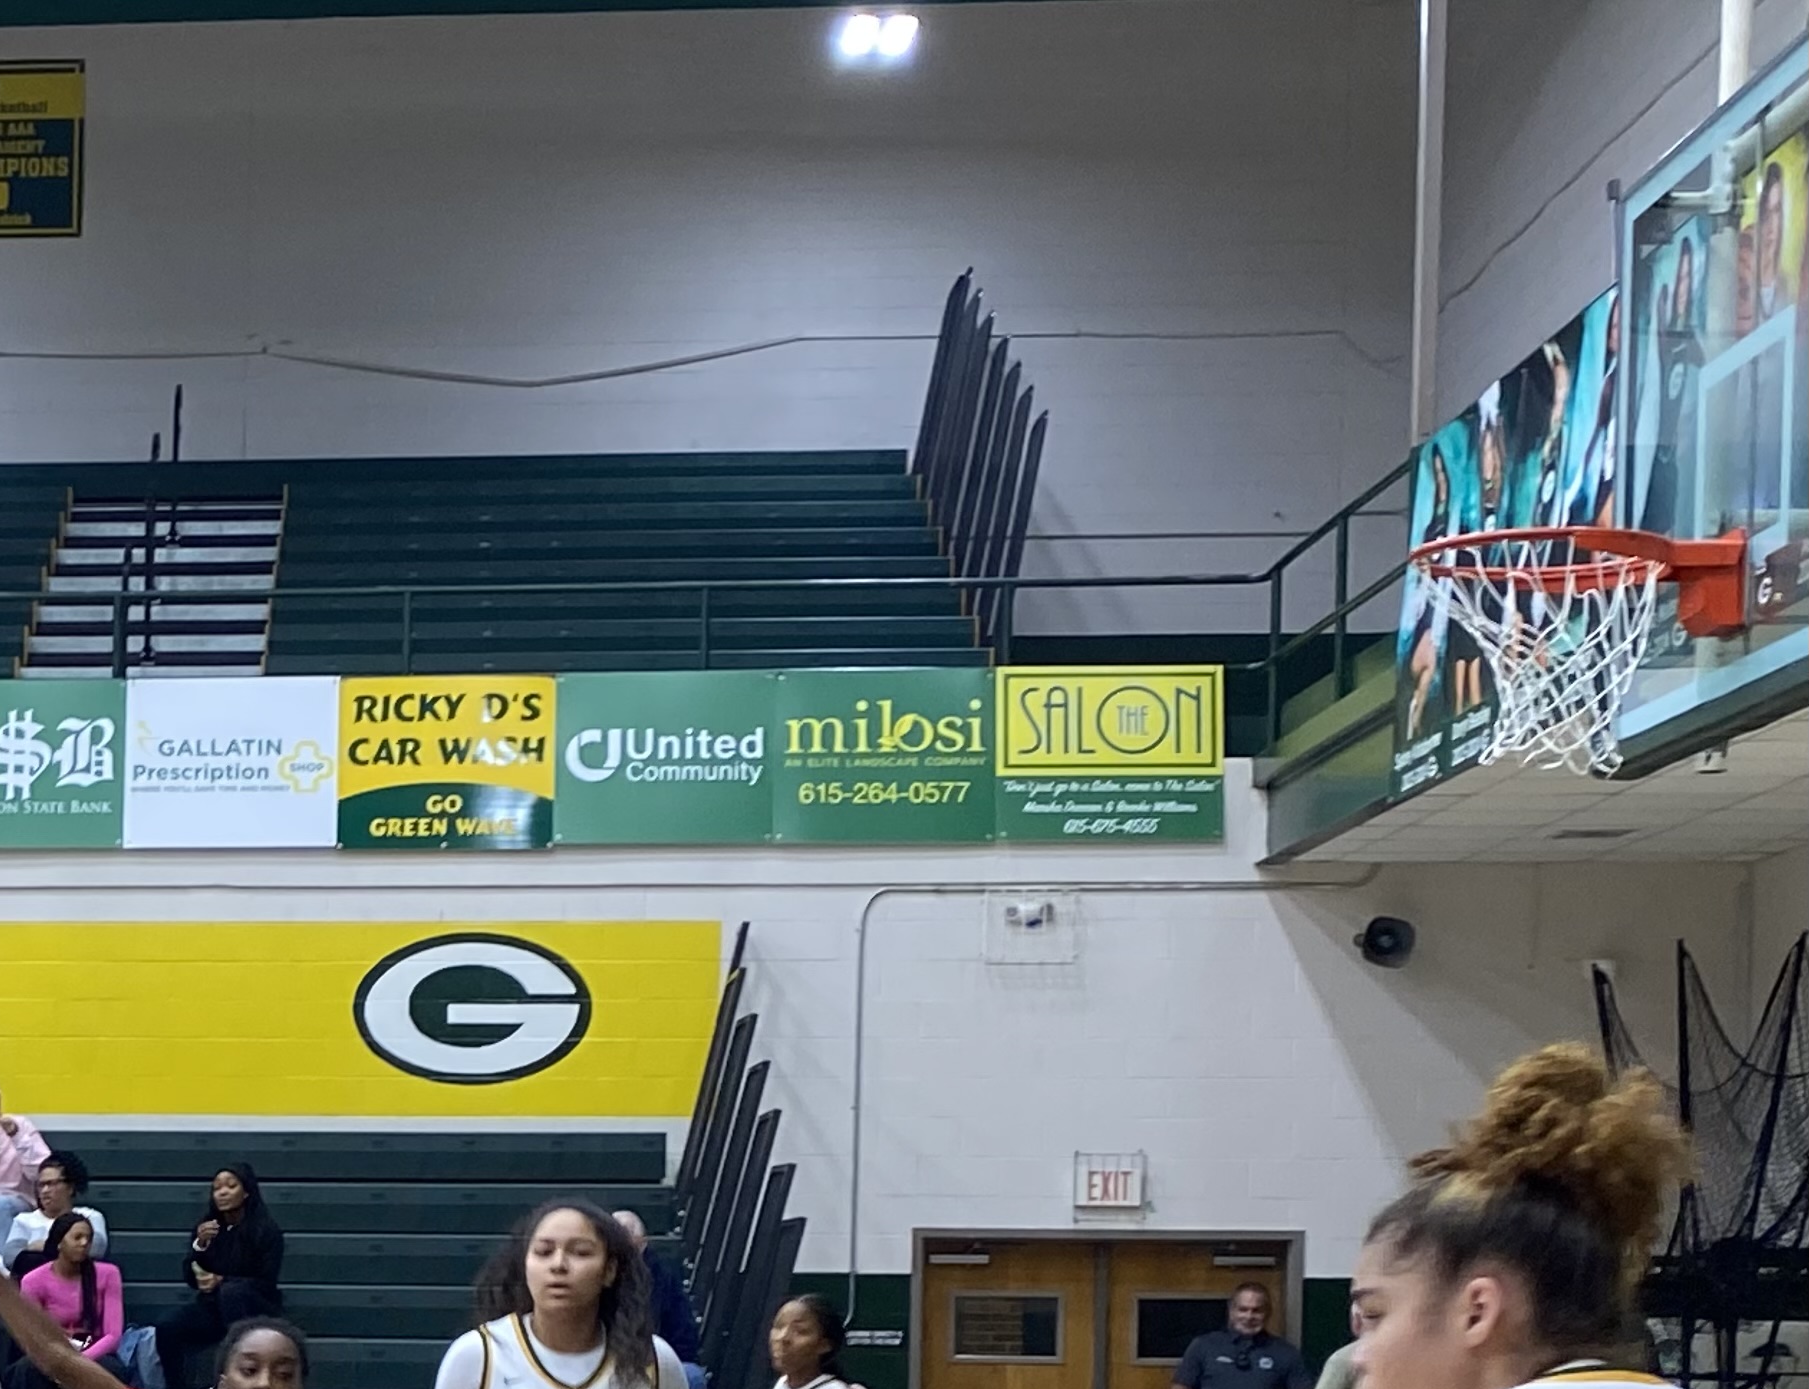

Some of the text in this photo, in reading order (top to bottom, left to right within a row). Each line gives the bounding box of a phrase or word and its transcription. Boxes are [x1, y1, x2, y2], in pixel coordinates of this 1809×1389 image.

[353, 693, 542, 723] RICKY D'S
[1017, 685, 1202, 755] SALON
[1117, 705, 1149, 736] THE
[784, 699, 987, 754] milosi
[158, 739, 282, 757] GALLATIN
[348, 738, 421, 766] CAR
[626, 727, 764, 760] United
[132, 763, 269, 783] Prescription
[626, 760, 763, 786] Community
[426, 794, 463, 813] GO
[798, 781, 971, 804] 615-264-0577
[21, 800, 66, 814] STATE
[70, 800, 112, 814] BANK
[369, 817, 447, 837] GREEN
[1088, 1170, 1133, 1201] EXIT
